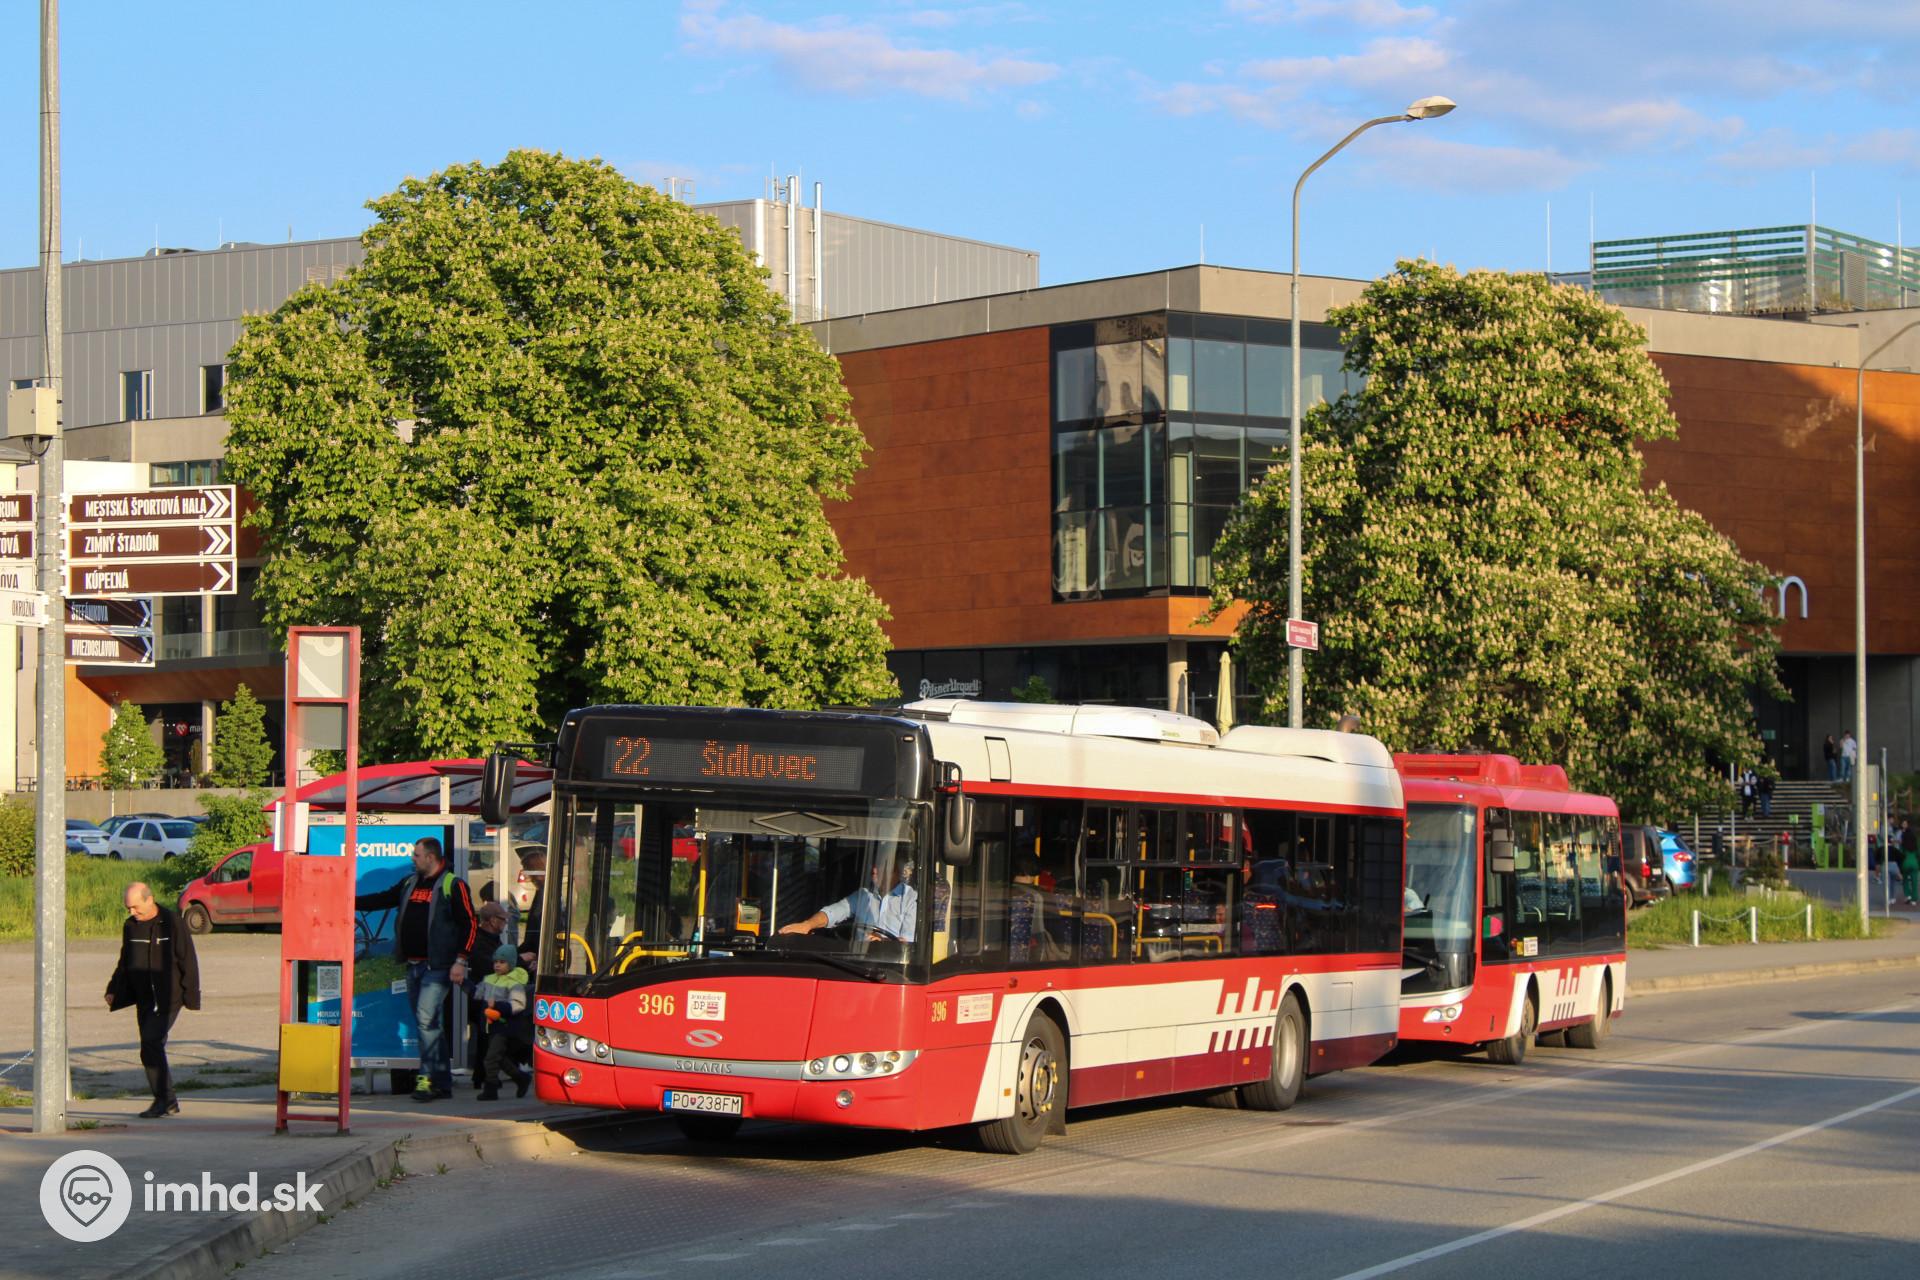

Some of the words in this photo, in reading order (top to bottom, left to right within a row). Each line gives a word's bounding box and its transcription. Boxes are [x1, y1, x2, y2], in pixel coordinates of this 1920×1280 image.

[85, 497, 129, 517] MESTSKÁ
[131, 496, 180, 516] ŠPORTOVÁ
[182, 497, 207, 514] HALA
[84, 533, 115, 553] ZIMNÝ
[117, 532, 160, 552] ŠTADIÓN
[85, 569, 129, 590] KÚPEĽNÁ
[11, 599, 36, 618] OKRUŽNÁ
[71, 639, 120, 657] HVIEZDOSLAVOVA
[919, 678, 951, 699] Pilsner
[949, 678, 980, 696] Urquell
[613, 736, 651, 775] 22
[700, 739, 817, 781] Šidlovec
[638, 993, 675, 1016] 396
[931, 1000, 947, 1022] 396
[675, 1060, 732, 1074] SOLARIS
